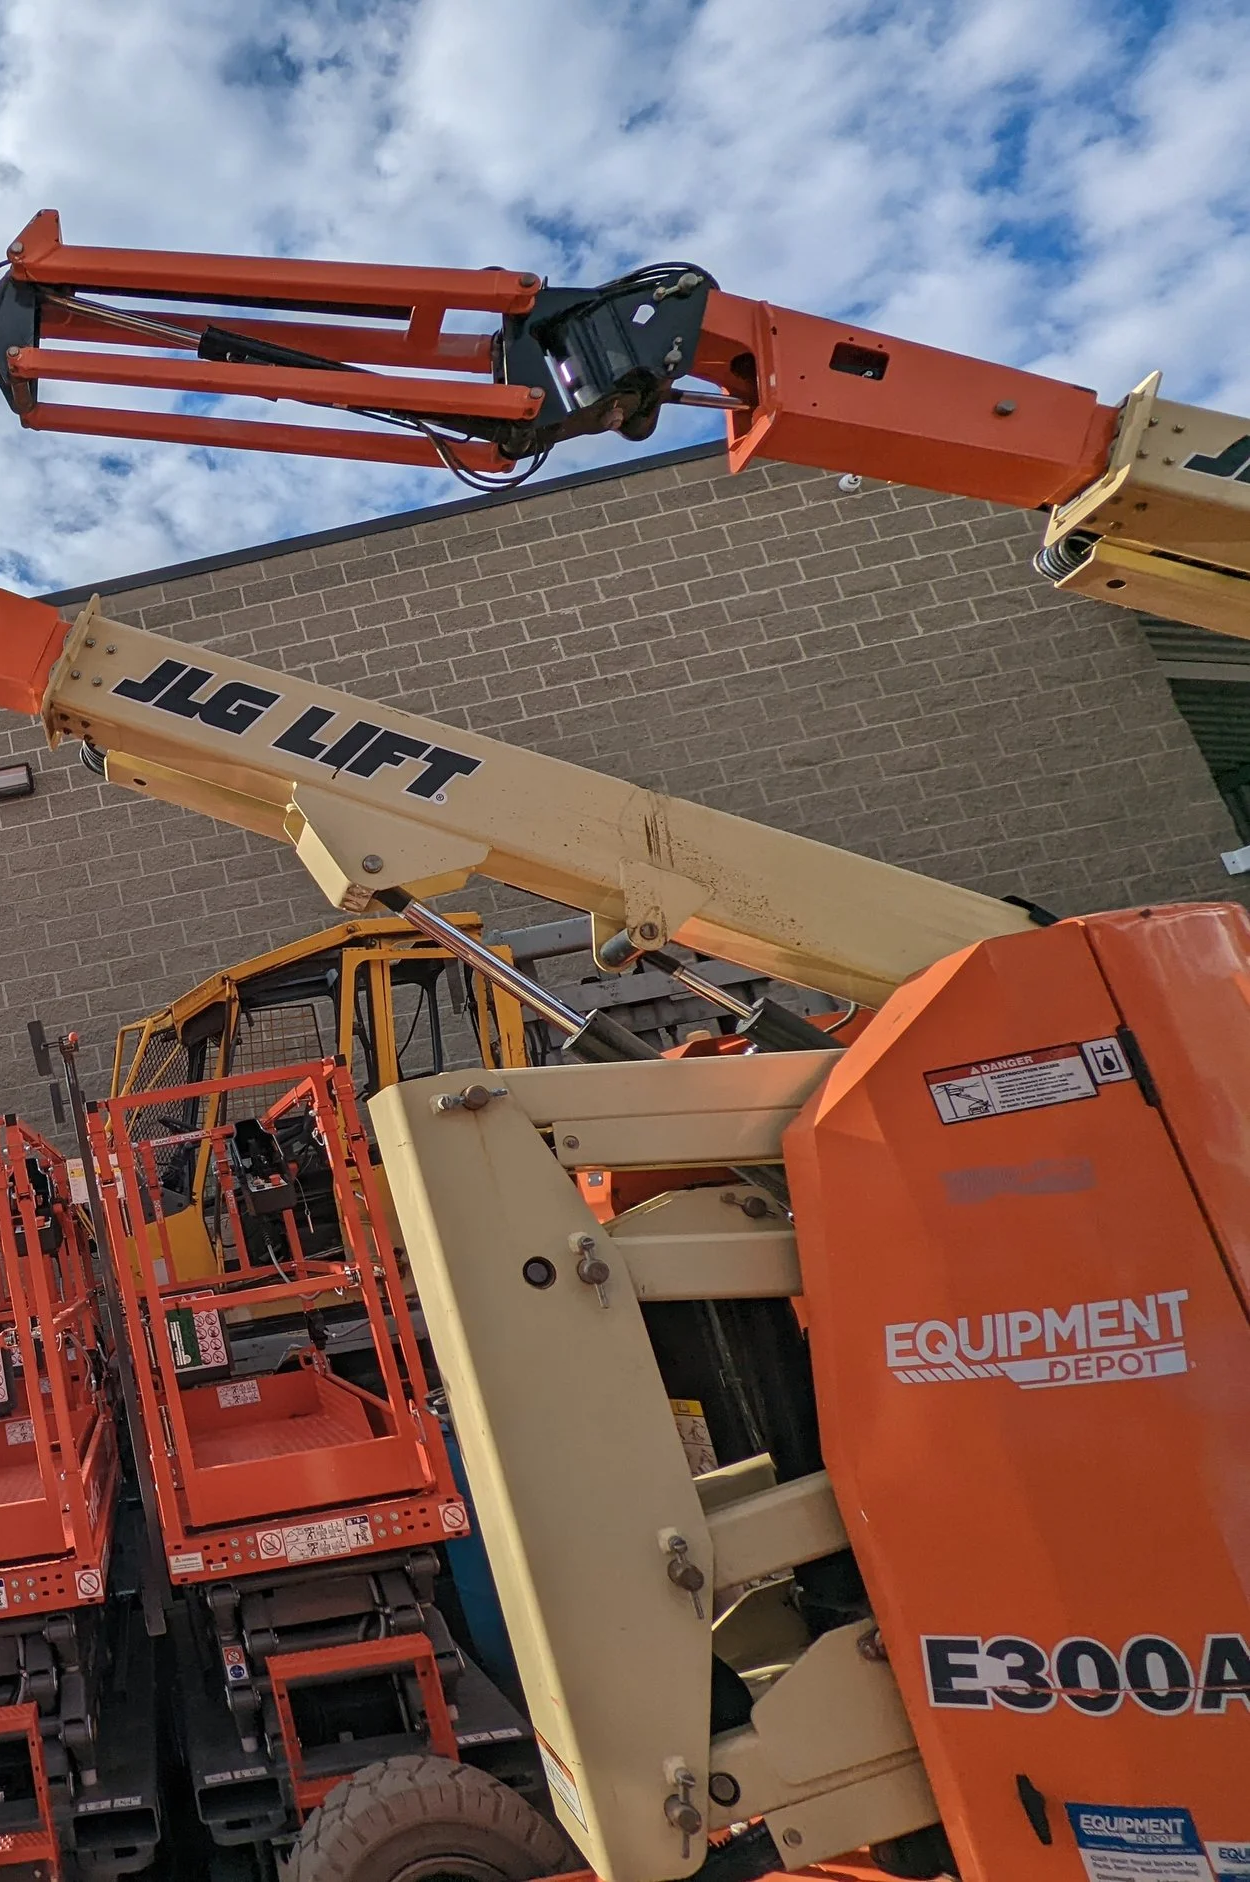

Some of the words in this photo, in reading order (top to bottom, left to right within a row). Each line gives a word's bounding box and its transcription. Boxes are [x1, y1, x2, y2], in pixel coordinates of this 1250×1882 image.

[112, 658, 282, 734] JLG
[272, 705, 484, 799] LIFT
[981, 1056, 1034, 1073] DANGER
[885, 1290, 1188, 1372] EQUIPMENT
[1048, 1351, 1161, 1382] DEPOT
[1079, 1814, 1185, 1836] EQUIPMENT
[1136, 1834, 1173, 1844] DEPOT
